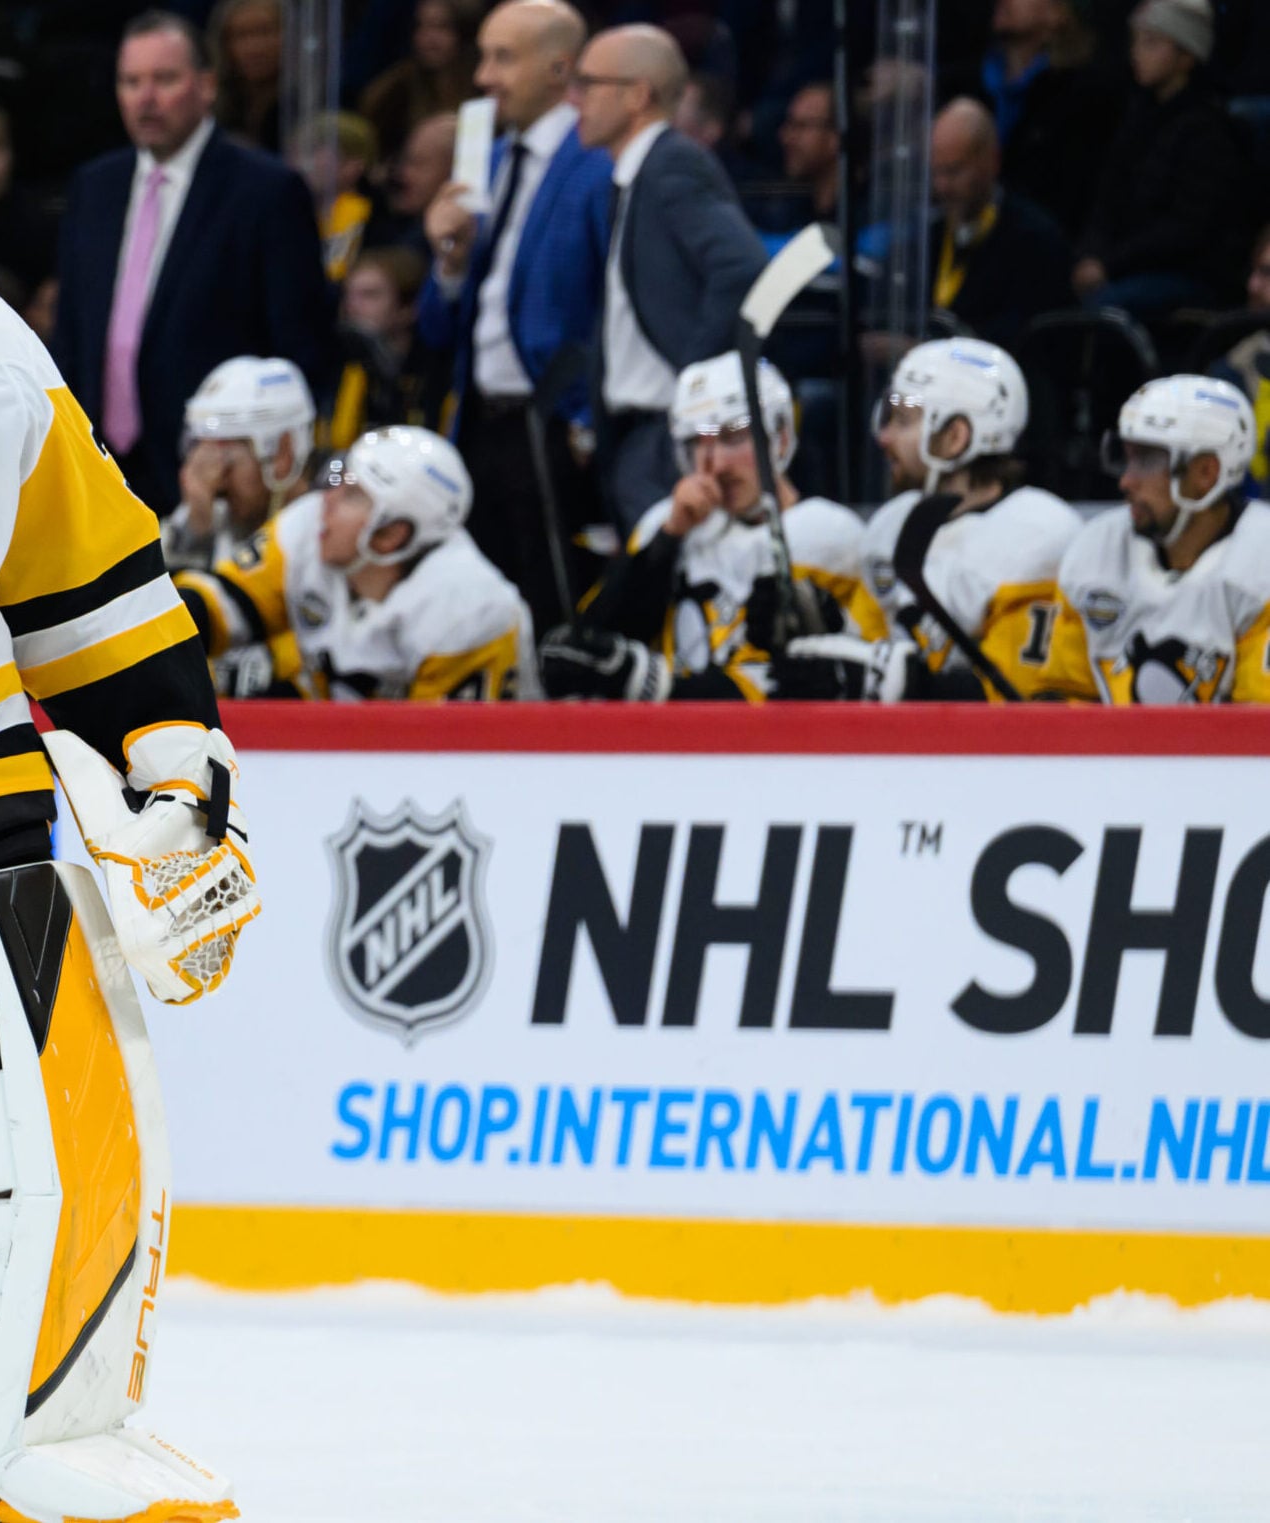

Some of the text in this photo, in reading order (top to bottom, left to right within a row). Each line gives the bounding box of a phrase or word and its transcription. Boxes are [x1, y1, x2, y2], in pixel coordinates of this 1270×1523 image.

[363, 862, 458, 987] NHL
[531, 823, 895, 1030] NHL
[127, 1188, 166, 1403] TRUE
